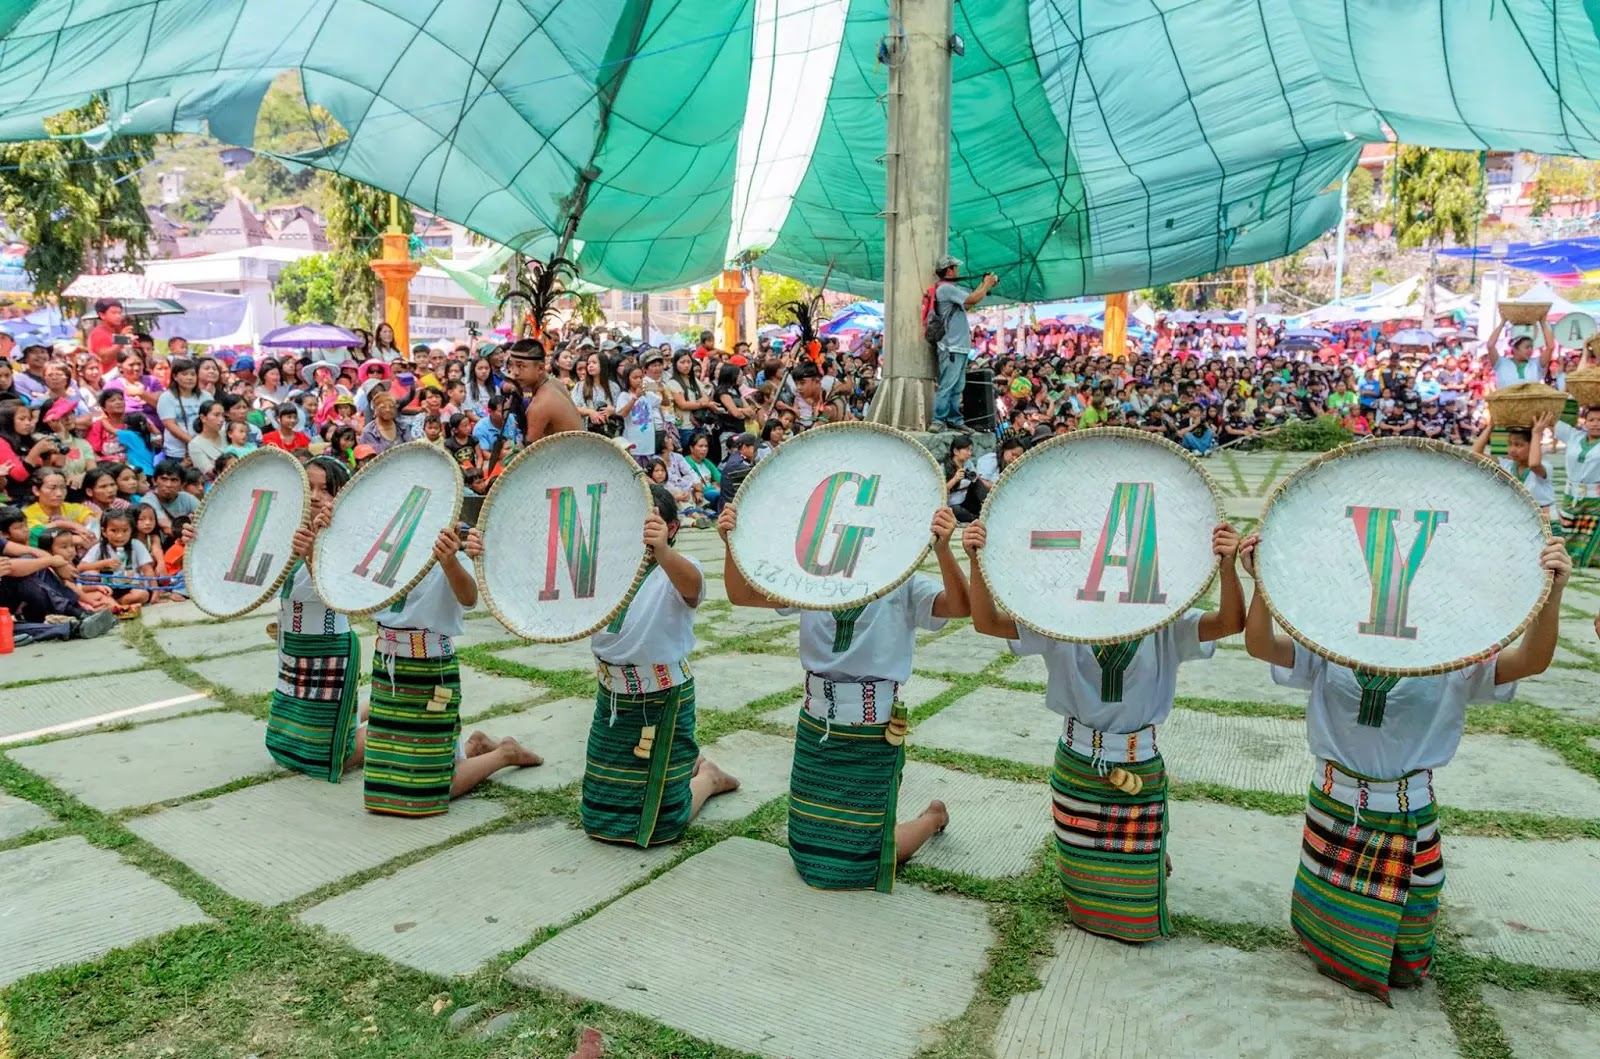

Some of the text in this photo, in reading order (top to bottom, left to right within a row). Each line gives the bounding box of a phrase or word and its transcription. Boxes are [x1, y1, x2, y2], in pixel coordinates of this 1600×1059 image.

[1569, 319, 1583, 341] A
[224, 489, 278, 587] L
[352, 484, 432, 588] A
[538, 482, 607, 601] N
[795, 471, 881, 578] G
[1345, 505, 1449, 640] Y
